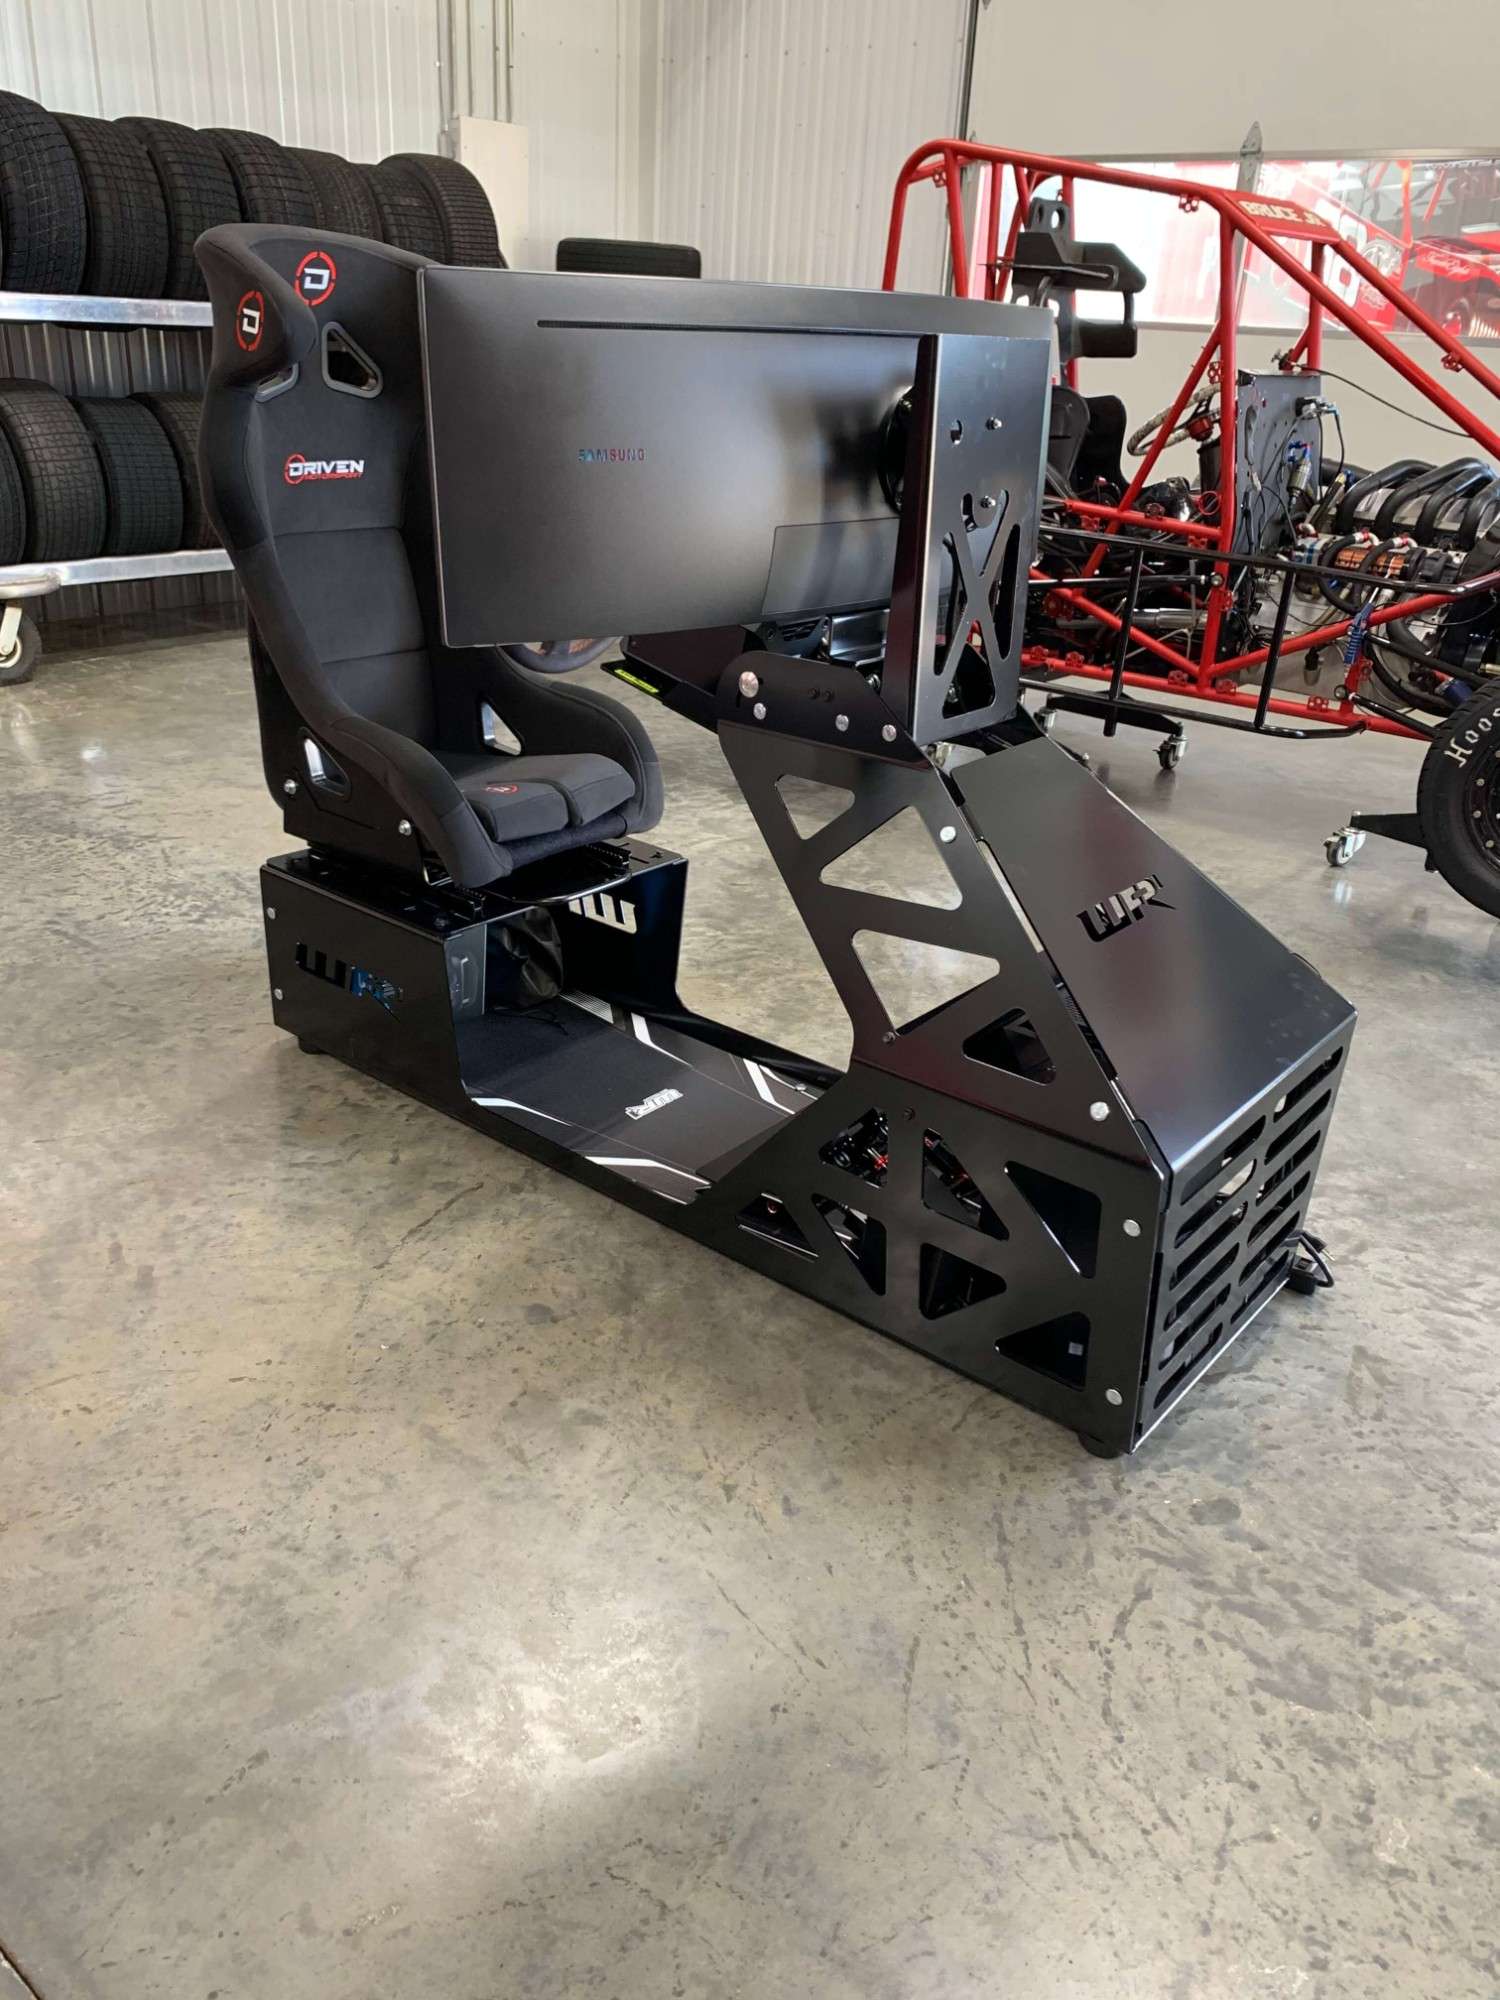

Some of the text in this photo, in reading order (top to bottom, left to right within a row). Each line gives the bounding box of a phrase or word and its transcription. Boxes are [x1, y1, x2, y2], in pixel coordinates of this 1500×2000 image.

[1238, 200, 1303, 222] BRUCE
[578, 447, 645, 462] SAMSUNG
[288, 459, 365, 477] DRIVEN
